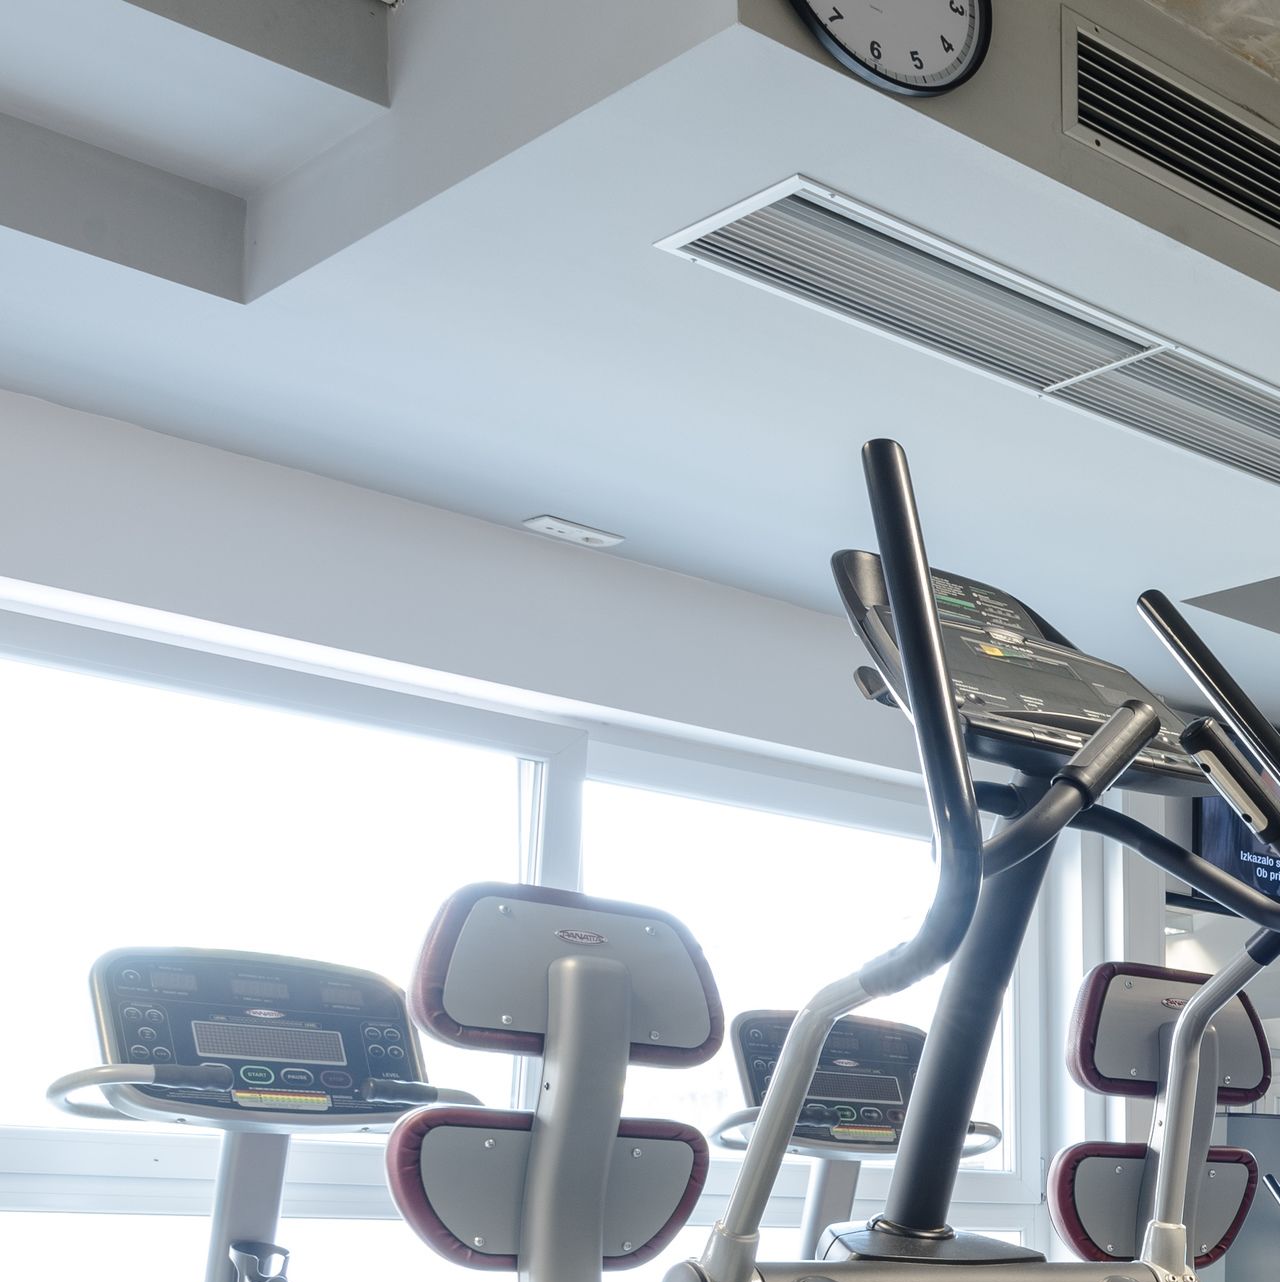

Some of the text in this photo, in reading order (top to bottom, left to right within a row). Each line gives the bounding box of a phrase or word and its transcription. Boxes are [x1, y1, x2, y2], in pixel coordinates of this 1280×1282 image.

[828, 7, 844, 23] 7
[870, 40, 882, 60] 6
[940, 35, 954, 54] 4
[910, 51, 923, 70] 5
[1240, 851, 1274, 867] Izkazalo
[1256, 867, 1267, 879] Ob
